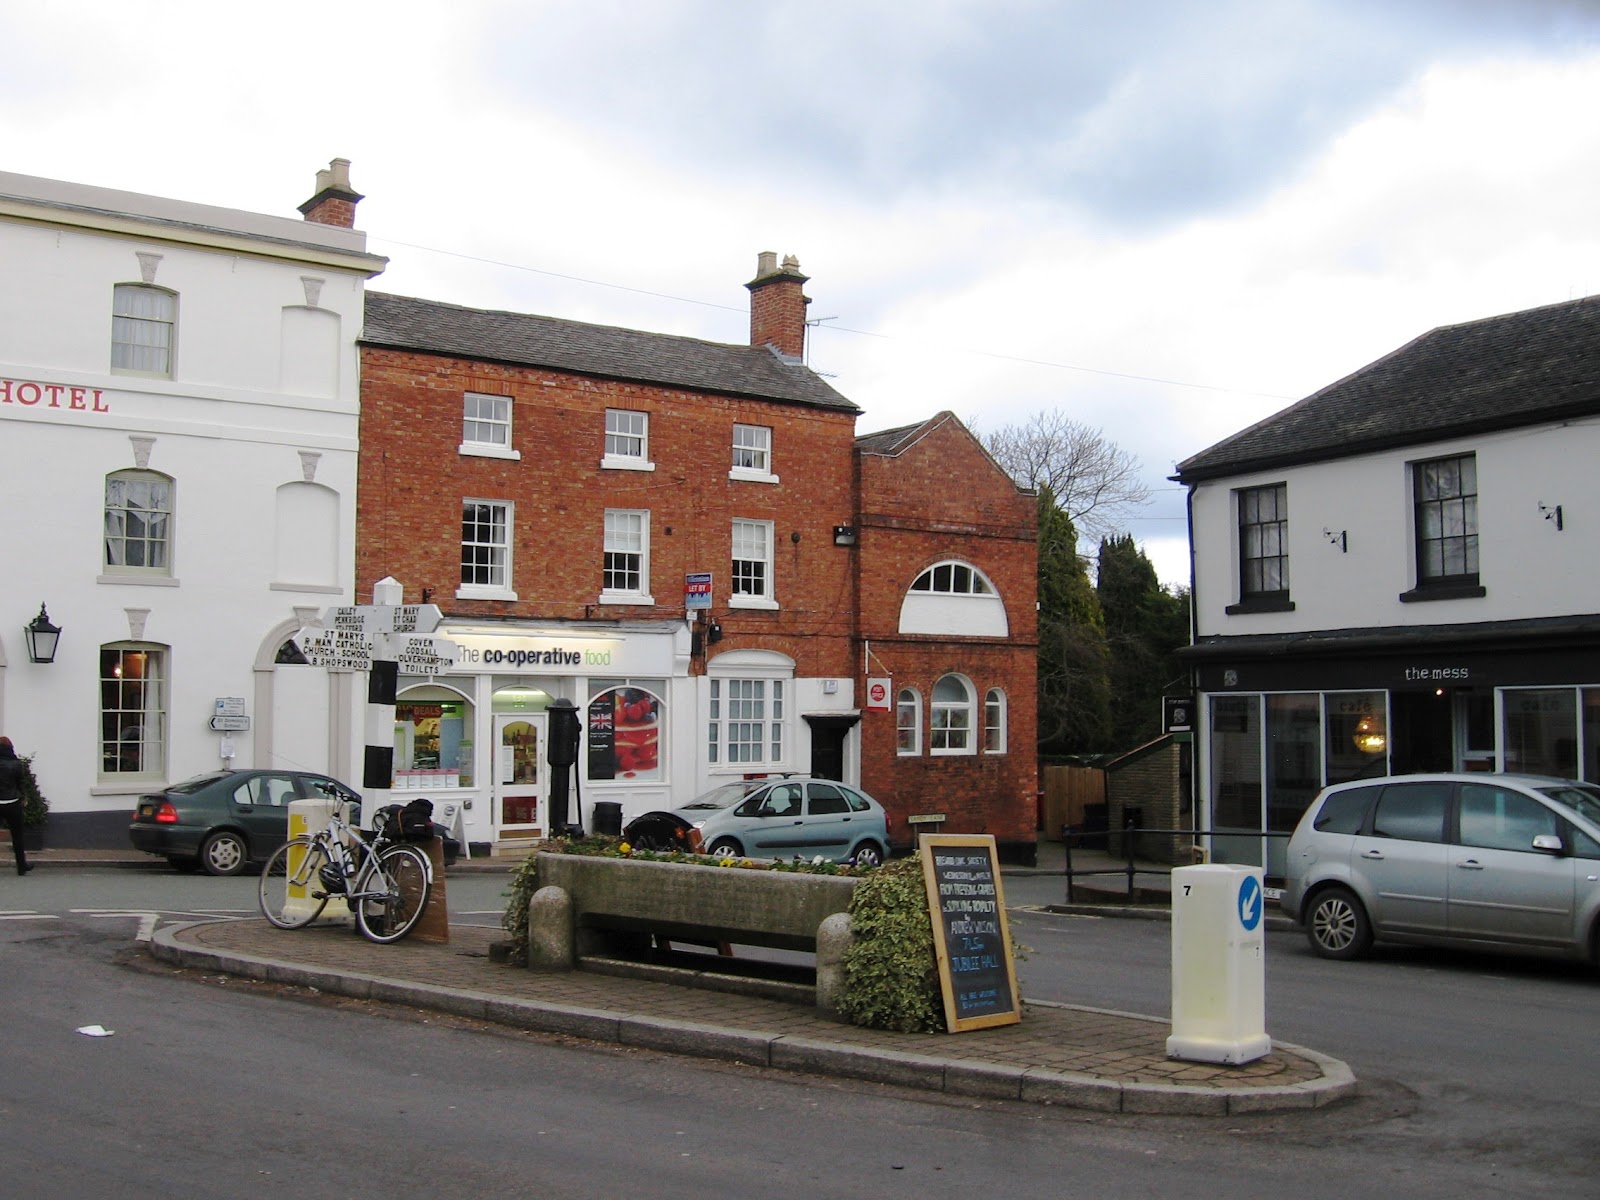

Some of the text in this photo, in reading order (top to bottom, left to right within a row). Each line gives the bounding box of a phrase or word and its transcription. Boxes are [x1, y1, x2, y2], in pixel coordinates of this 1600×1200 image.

[0, 381, 109, 412] HOTEL
[688, 584, 698, 592] LET
[394, 606, 420, 615] ST MARY
[402, 615, 417, 623] CHAD
[393, 624, 416, 632] CHURCH
[324, 630, 365, 641] ST MARYS
[304, 637, 374, 651] RMAN CATHOLIC
[409, 638, 433, 647] COVEN
[303, 645, 335, 656] CHURCH
[342, 649, 370, 659] SCHOOL
[406, 647, 438, 656] CODSALL
[398, 654, 453, 666] OLVERHAMPTON
[484, 648, 581, 667] co-operative
[585, 649, 611, 666] food
[405, 664, 439, 674] TOILETS
[413, 706, 441, 715] DEALS
[1183, 885, 1191, 896] 7
